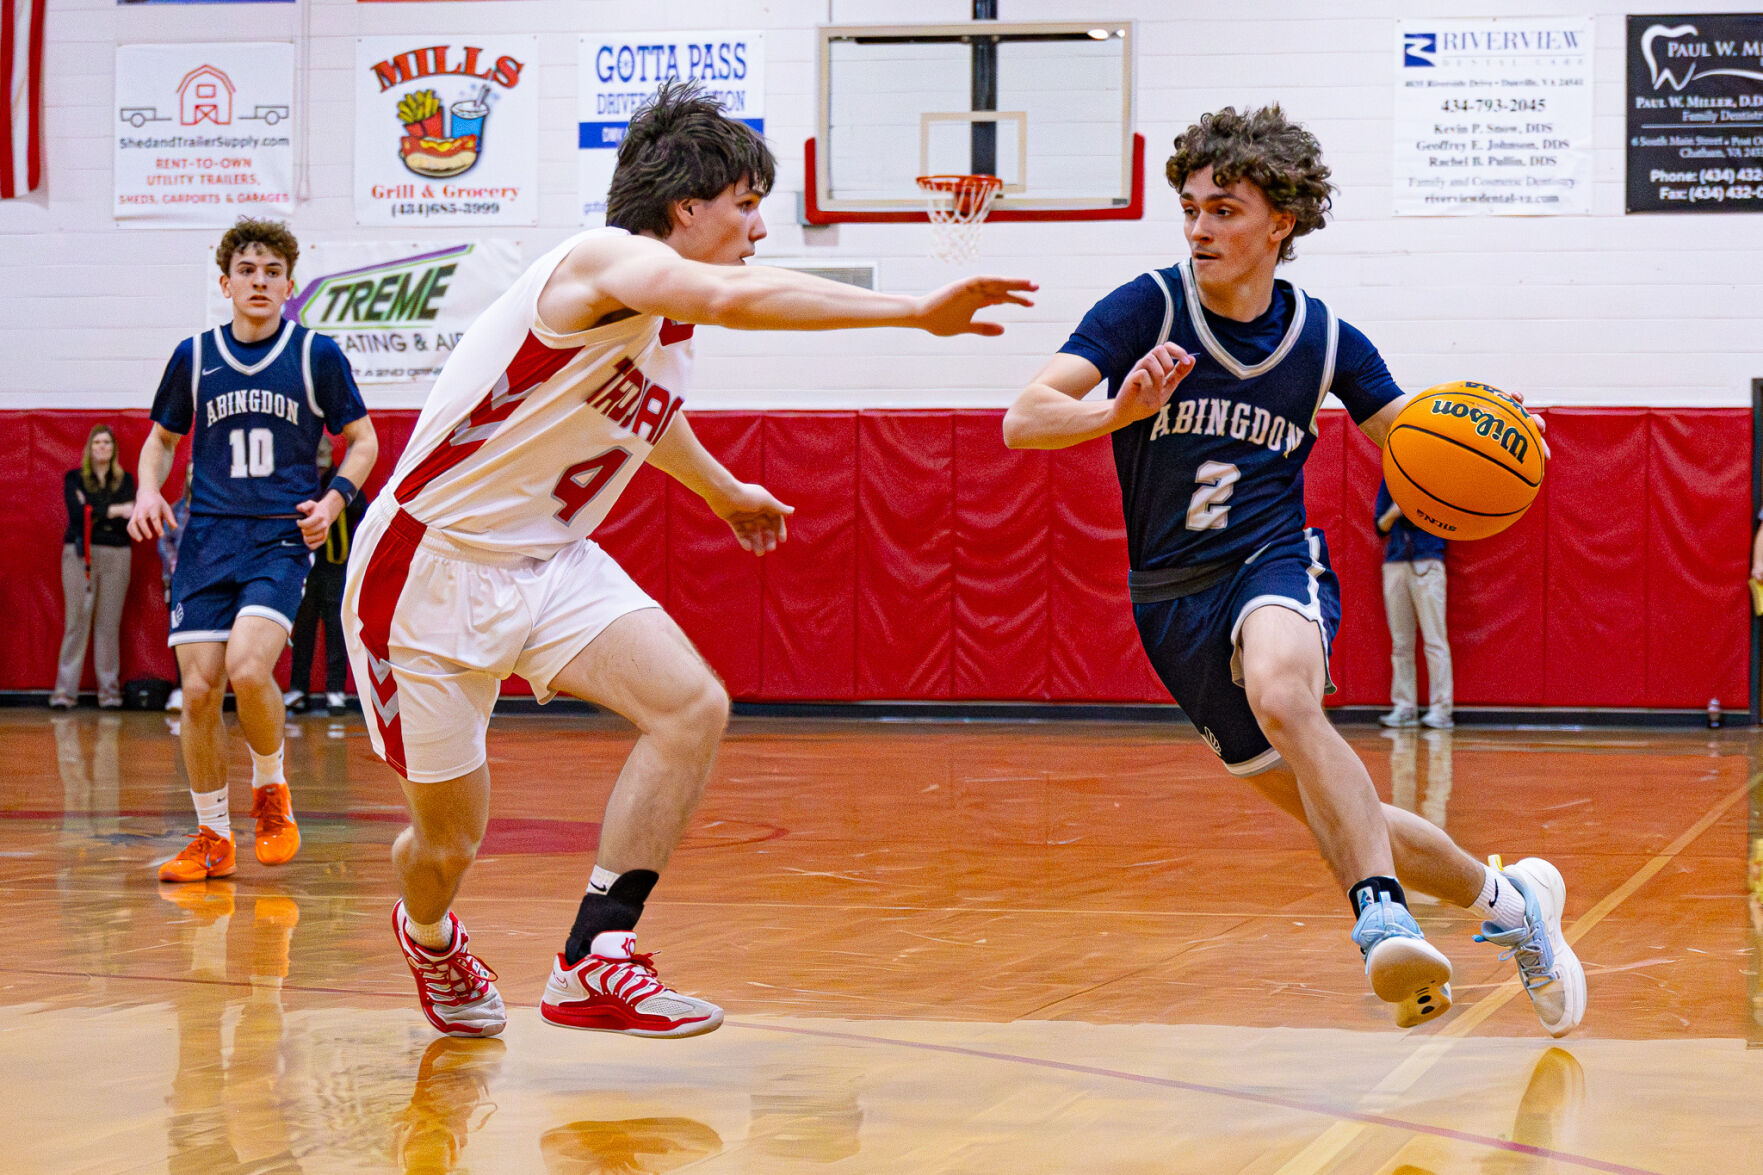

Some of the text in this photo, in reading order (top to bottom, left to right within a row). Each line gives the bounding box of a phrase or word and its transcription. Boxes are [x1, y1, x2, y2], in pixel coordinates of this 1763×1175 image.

[1443, 31, 1579, 50] RIVERVIEW
[1667, 42, 1711, 57] PAUL
[1715, 41, 1737, 56] W.
[370, 45, 525, 93] MILLS
[596, 43, 746, 83] GOTTA PASS
[1441, 98, 1547, 113] 434-793-2045
[1636, 97, 1667, 109] PAUL
[119, 136, 290, 149] ShedandTrailerSupply.com
[156, 158, 252, 169] RENT-TO-OWN
[147, 174, 261, 186] UTILITY TRAILERS,
[1650, 169, 1698, 183] Phone:
[1700, 167, 1735, 184] (434)
[371, 184, 520, 202] Grill & Grocery
[1689, 186, 1724, 202] (434)
[308, 262, 458, 323] TREME
[414, 333, 428, 351] &
[206, 389, 299, 428] ABINGDON
[1150, 398, 1305, 459] ABINGDON
[1431, 399, 1529, 465] Wilson
[229, 428, 275, 478] 10
[551, 445, 634, 527] 4
[1185, 460, 1241, 531] 2
